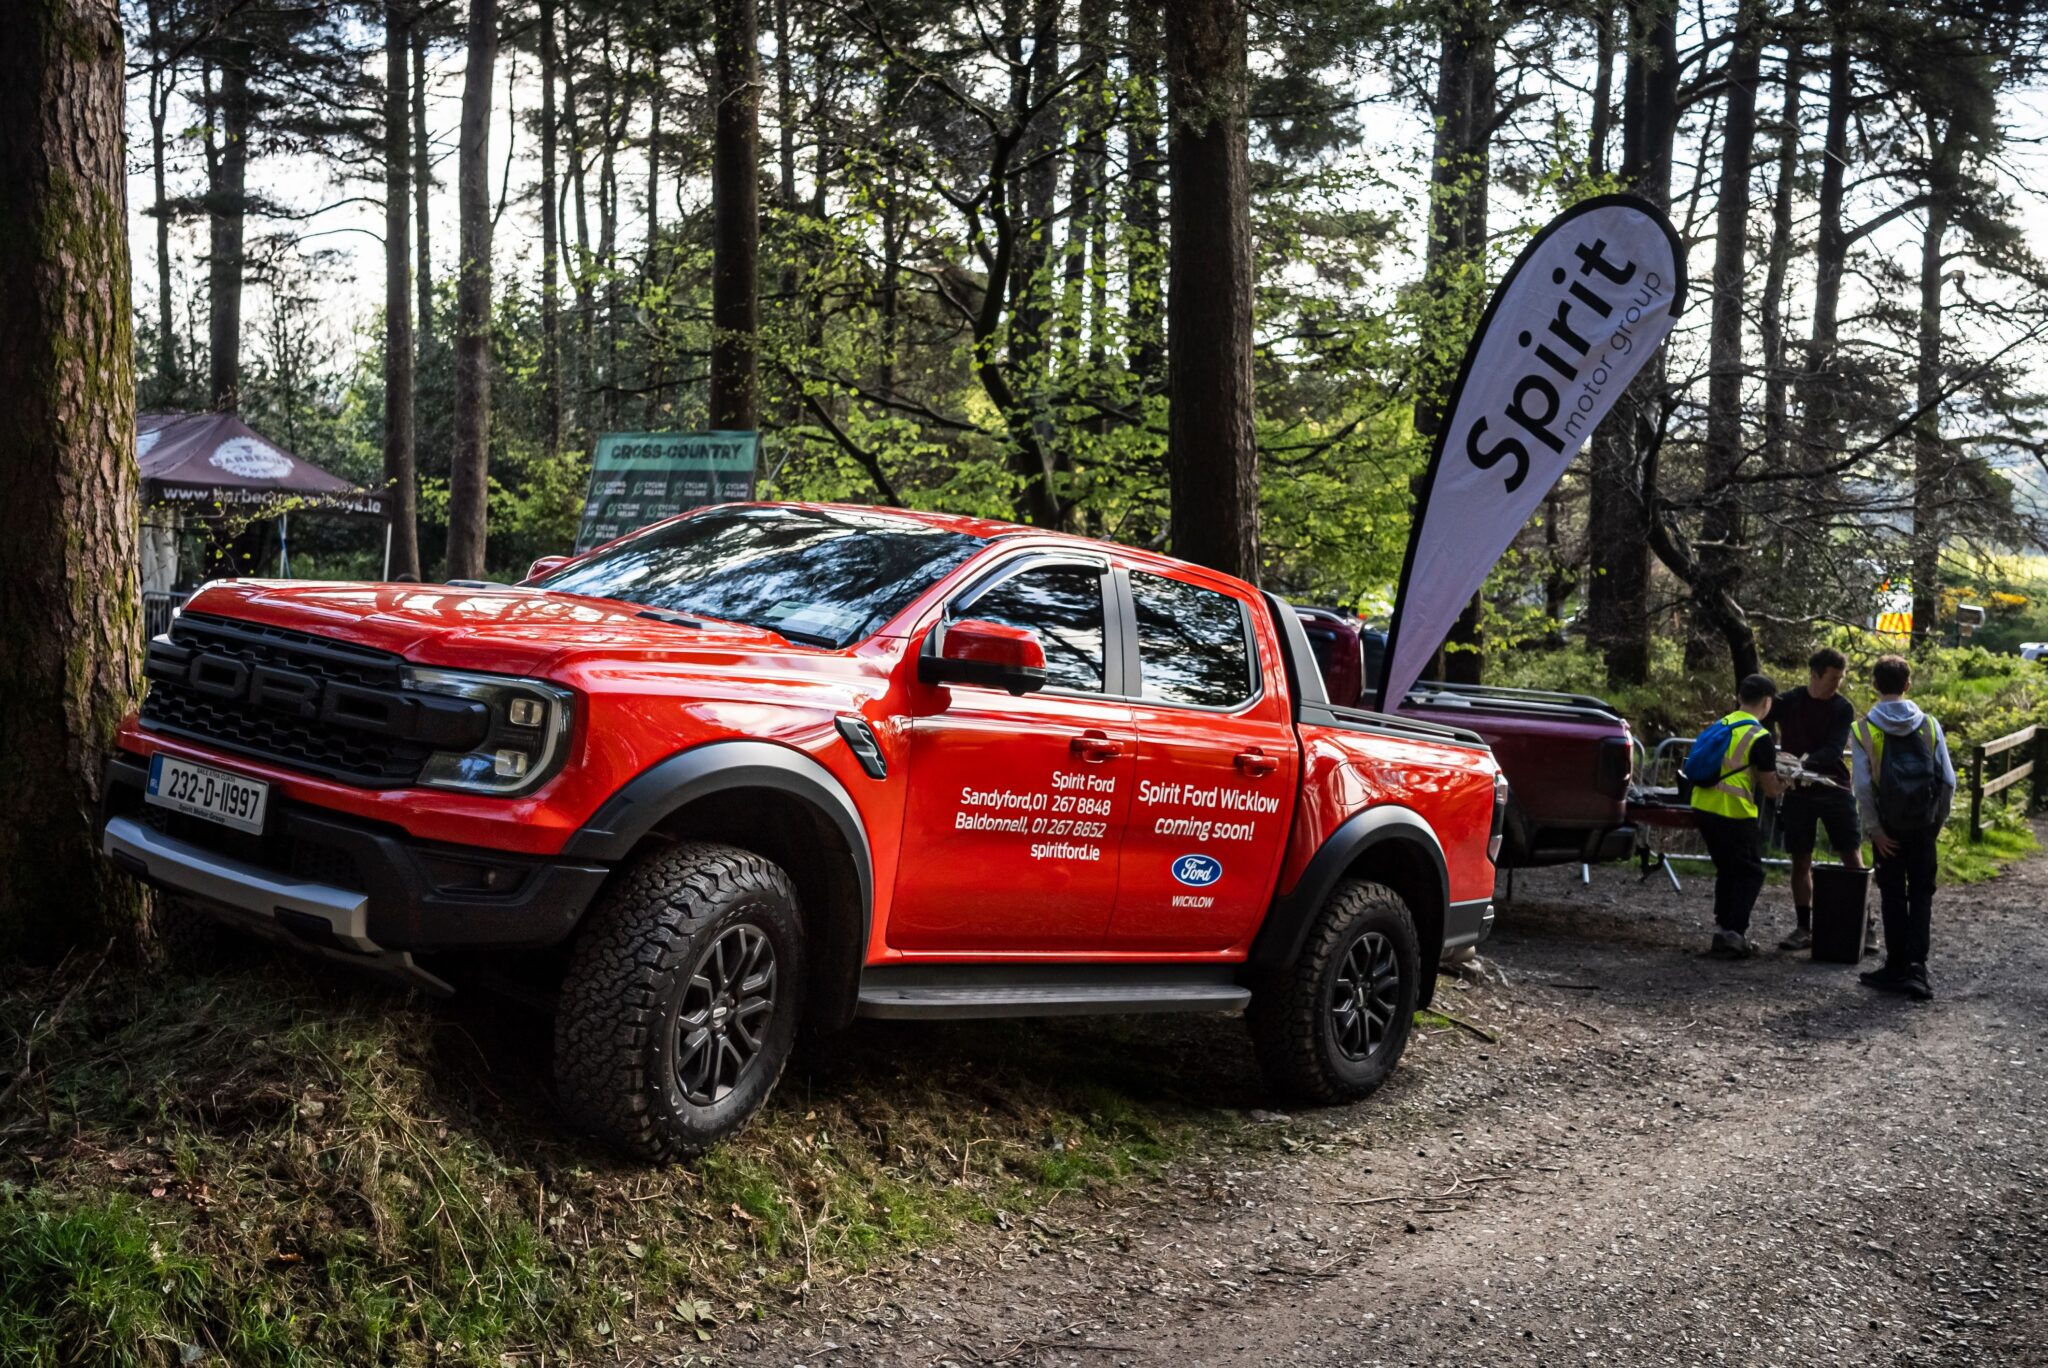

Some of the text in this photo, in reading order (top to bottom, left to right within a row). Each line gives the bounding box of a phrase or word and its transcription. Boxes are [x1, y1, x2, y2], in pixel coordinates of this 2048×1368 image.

[1466, 238, 1637, 494] Spirit
[1563, 271, 1662, 440] motor group
[611, 443, 743, 461] CROSS-COUNTRY
[168, 768, 260, 820] 232-D-11997
[1052, 770, 1115, 793] Spirit Ford
[1138, 779, 1279, 814] Spirit Ford Wicklow
[955, 811, 1028, 835] Baldonnell,
[1072, 821, 1107, 838] 8852
[1154, 816, 1255, 842] coming soon!
[1031, 840, 1100, 861] spiritford.ie
[1180, 857, 1212, 883] Ford
[1171, 894, 1214, 908] WICKLOW
